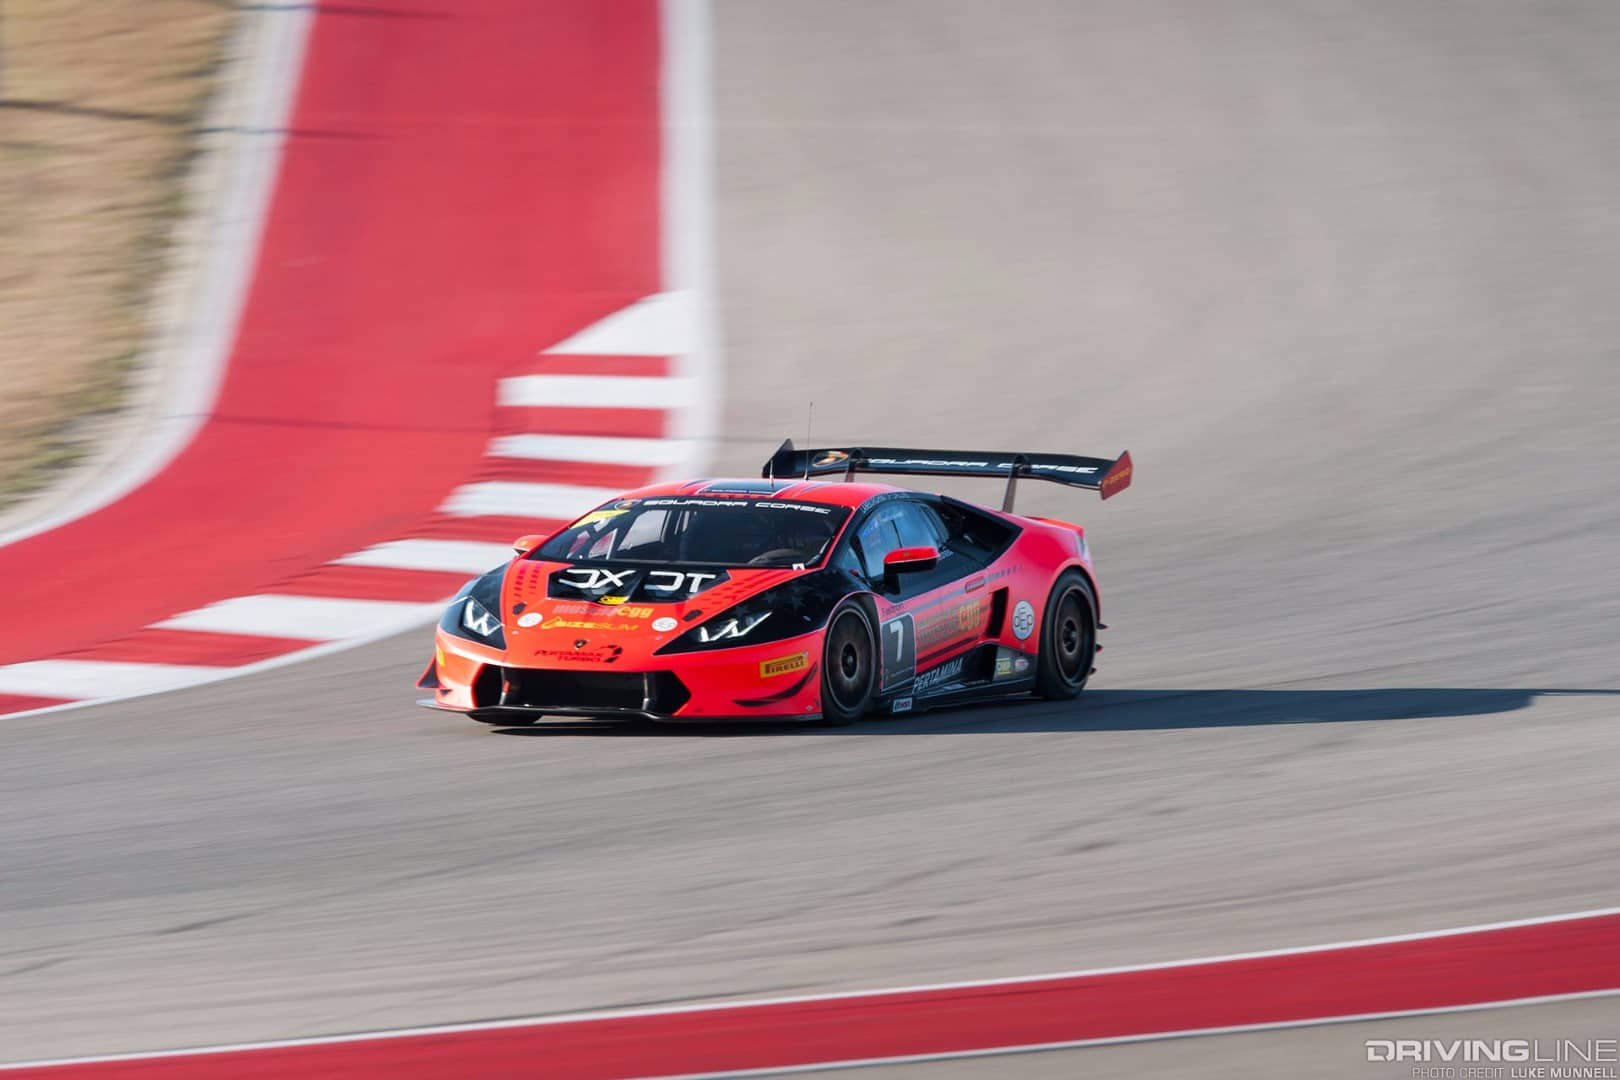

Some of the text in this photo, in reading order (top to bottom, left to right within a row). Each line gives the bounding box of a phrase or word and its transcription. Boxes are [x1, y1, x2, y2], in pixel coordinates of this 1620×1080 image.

[996, 462, 1099, 474] CRSE
[643, 499, 832, 515] SQUADRA CORSE
[889, 620, 904, 662] 7
[557, 655, 601, 663] TURBO
[765, 655, 804, 674] PIRELLI
[913, 657, 964, 690] PERTAMINA
